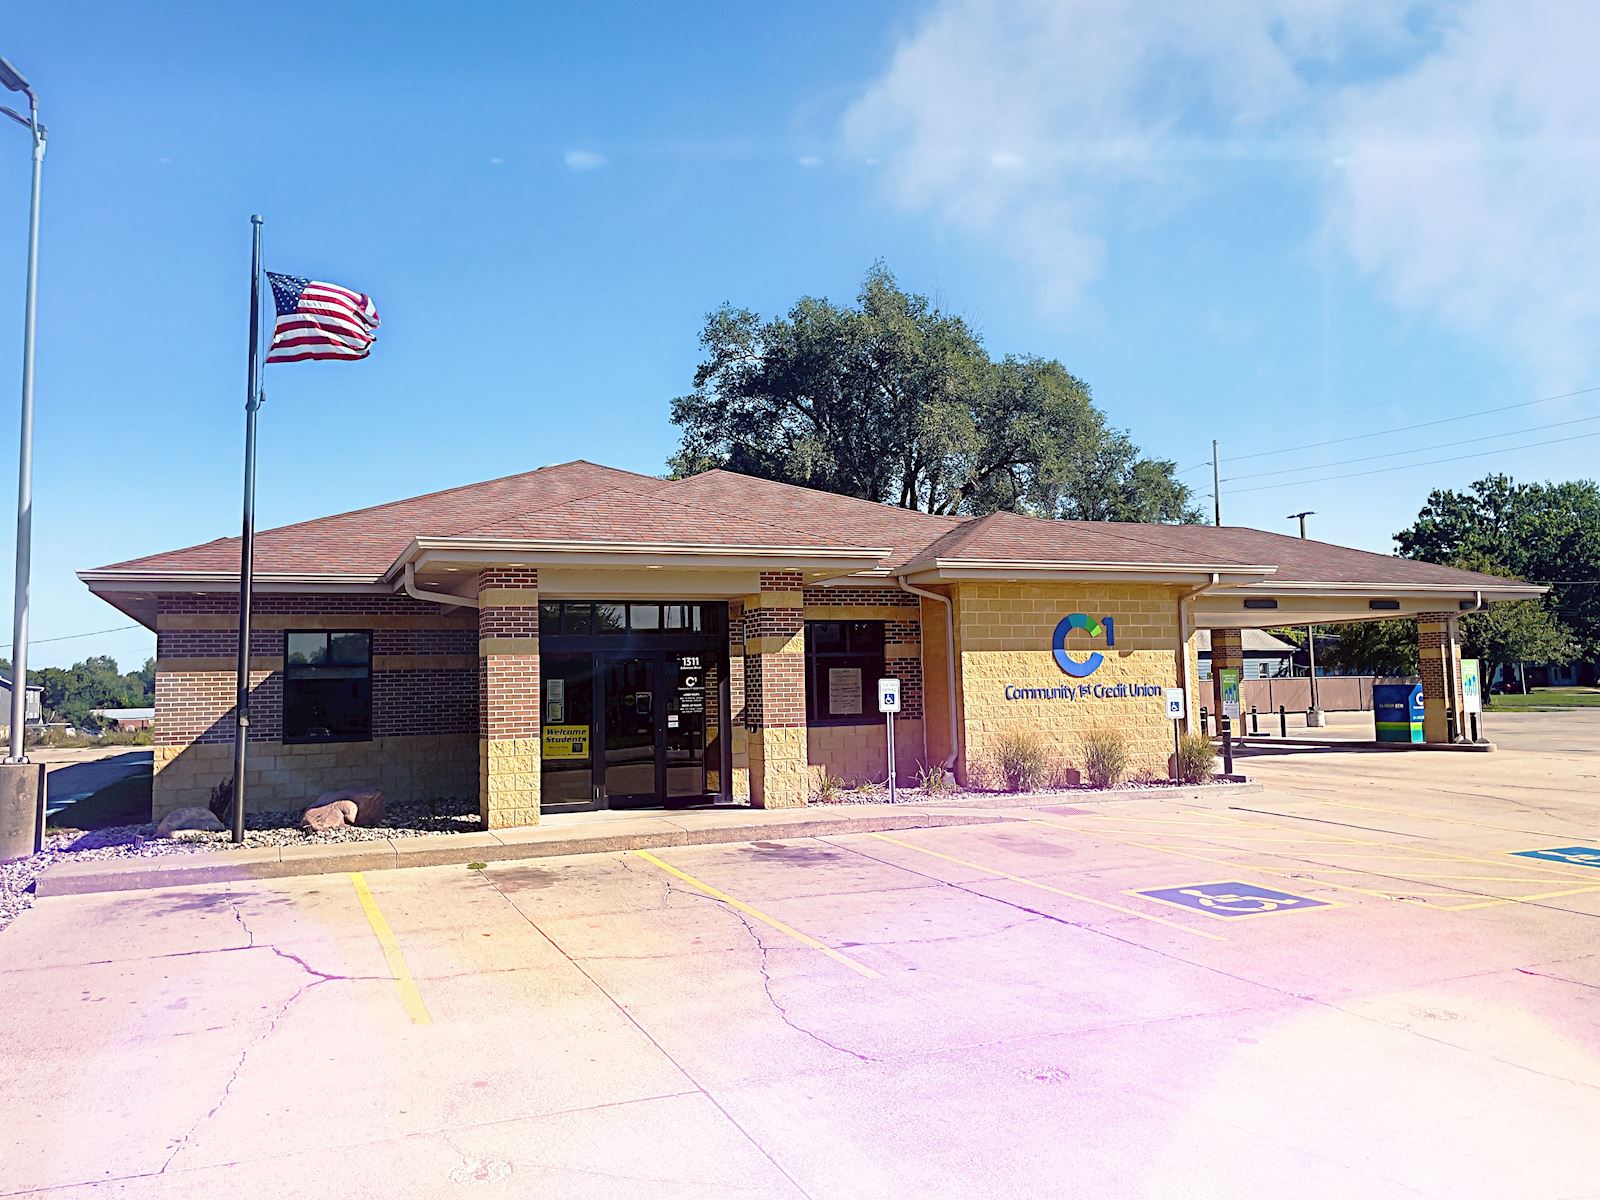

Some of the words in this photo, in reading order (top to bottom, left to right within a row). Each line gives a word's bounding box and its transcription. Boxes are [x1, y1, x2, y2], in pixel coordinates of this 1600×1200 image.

[682, 657, 699, 666] 1311
[1005, 684, 1076, 701] Community
[1077, 684, 1092, 698] 1st
[1094, 684, 1127, 698] Credit
[1129, 683, 1162, 697] Union
